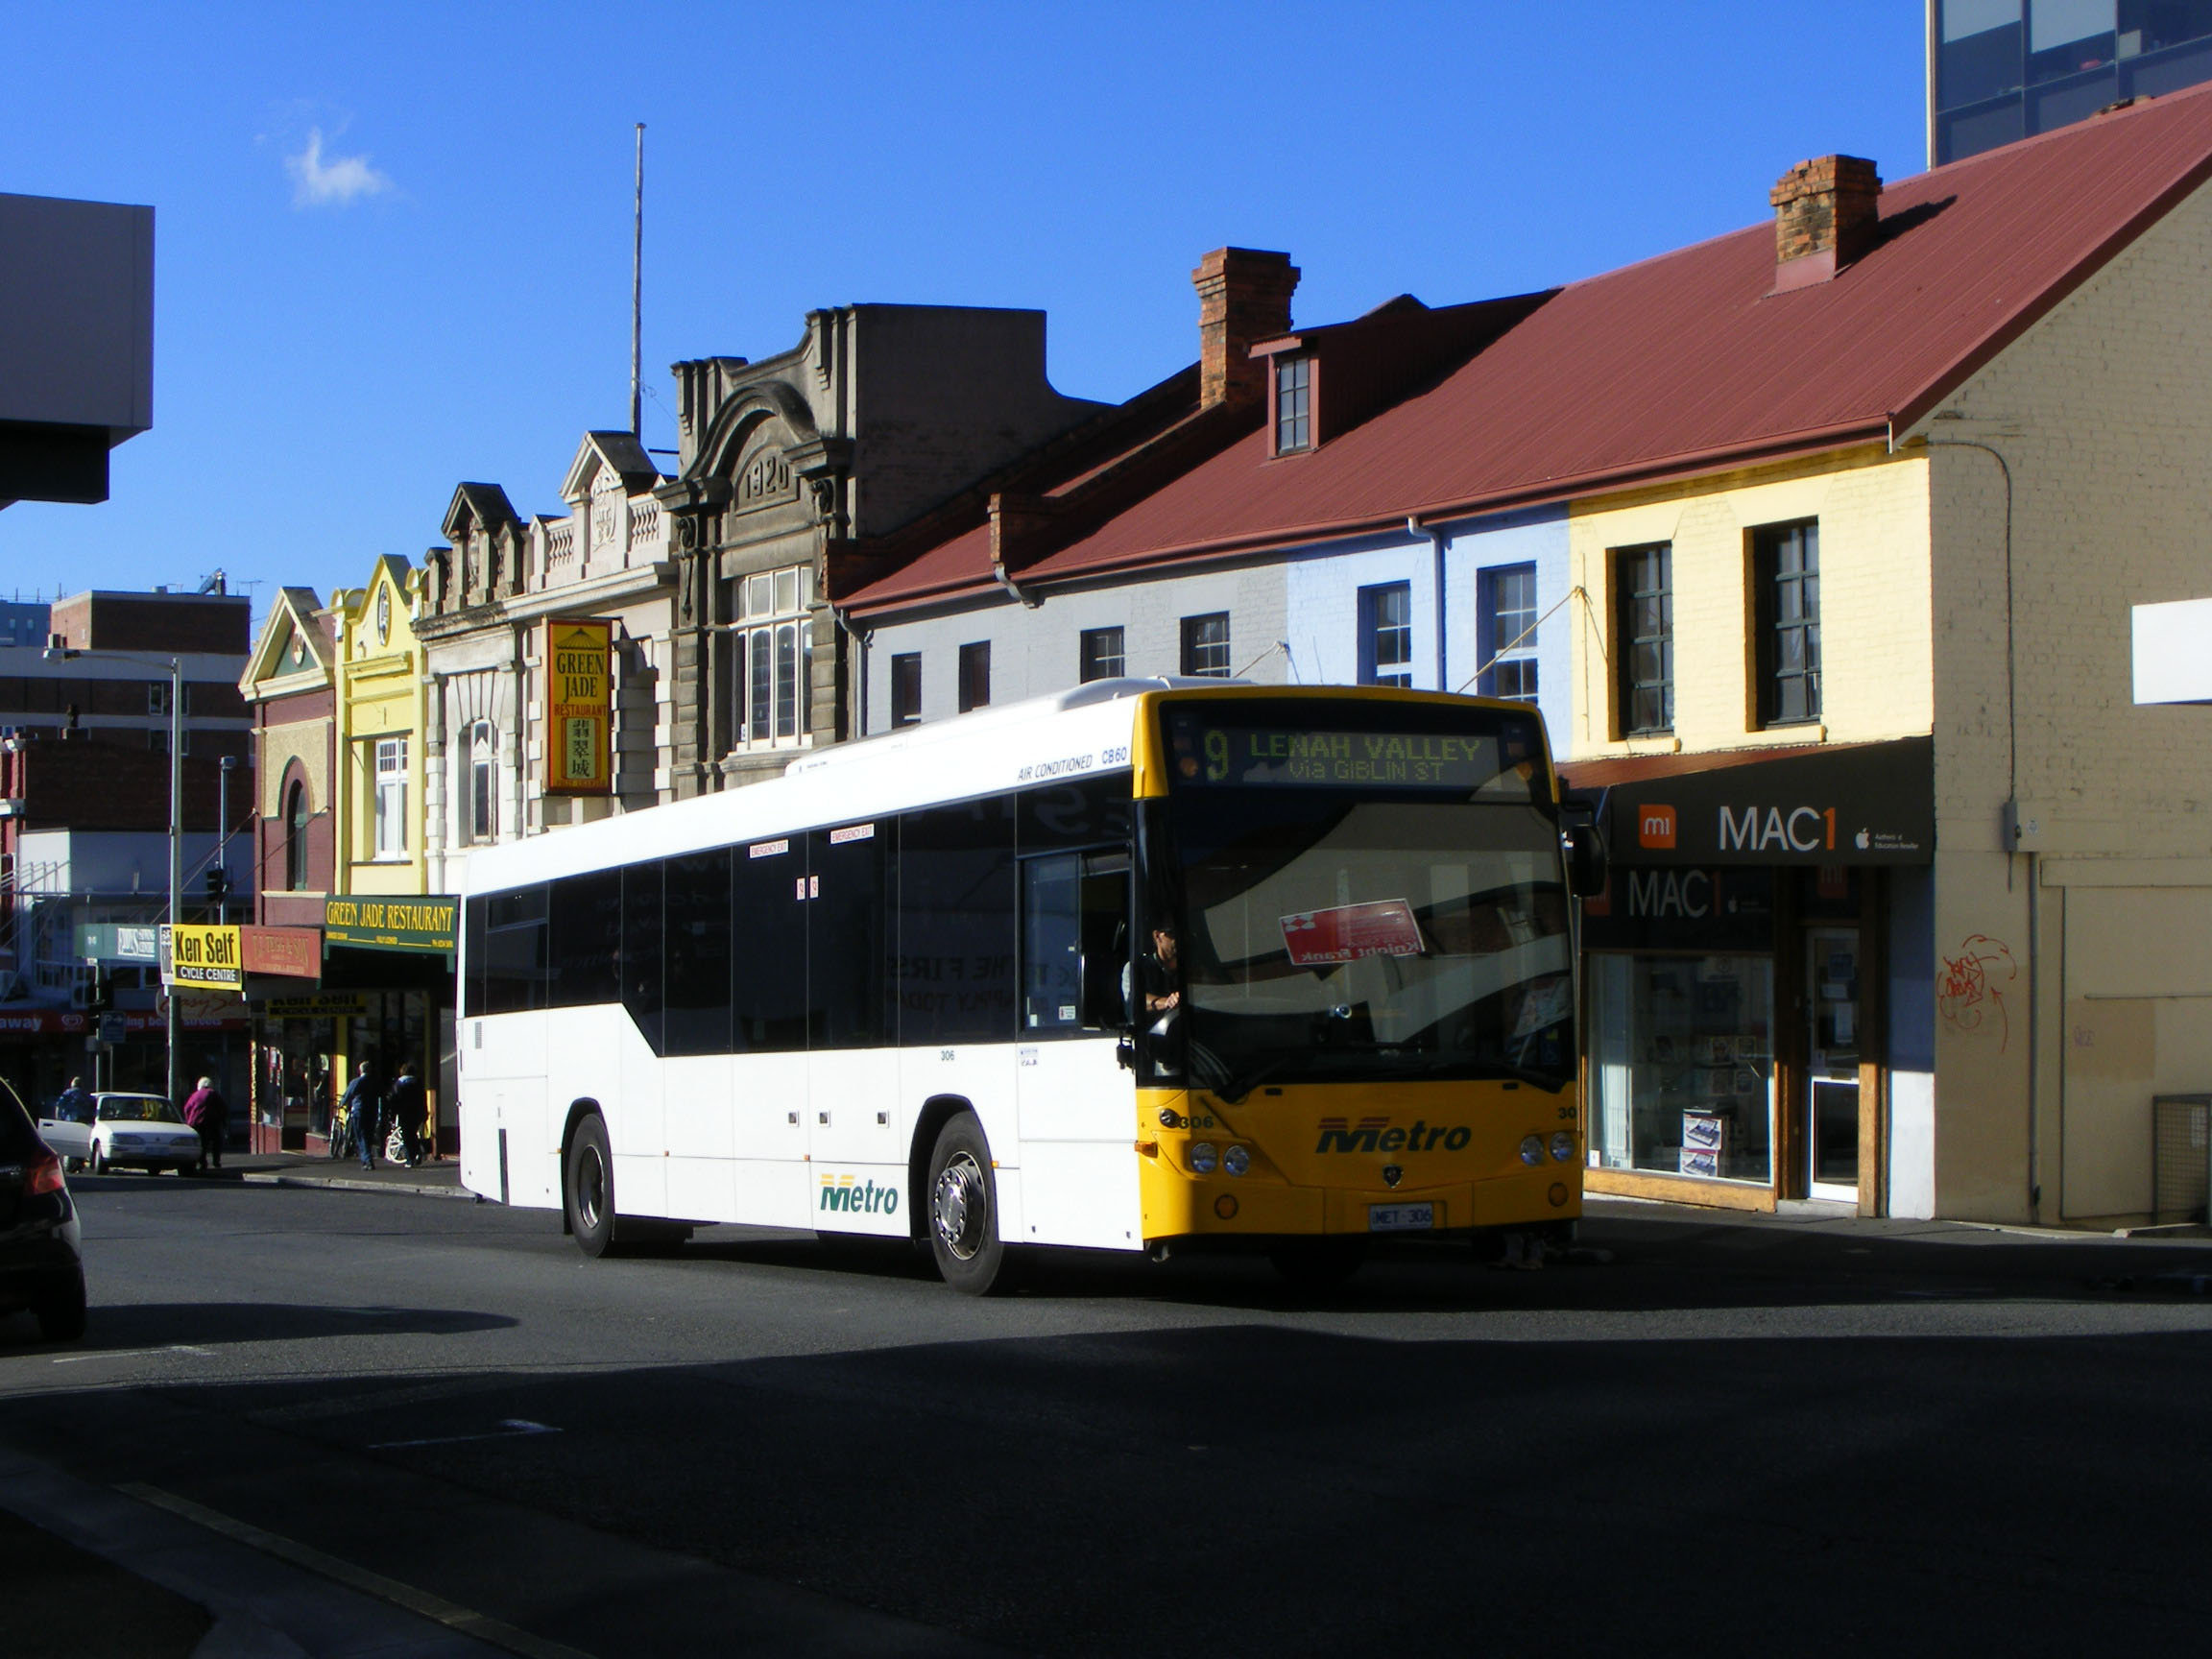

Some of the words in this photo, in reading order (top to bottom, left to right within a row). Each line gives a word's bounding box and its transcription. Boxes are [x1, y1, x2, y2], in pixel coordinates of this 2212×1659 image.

[556, 653, 605, 674] GREEN
[564, 676, 598, 703] JADE
[554, 704, 608, 717] RESTAURANT
[1204, 730, 1230, 781] 9
[1250, 733, 1351, 759] LENAH
[1364, 735, 1481, 761] VALLEY
[1018, 765, 1033, 781] AIR
[1035, 755, 1093, 779] CONDITIONED
[1288, 759, 1326, 780] via
[1415, 762, 1445, 781] ST
[832, 829, 861, 842] EMERGENCY
[861, 825, 873, 836] EXIT
[1718, 805, 1837, 852] MAC1
[751, 844, 776, 857] EMERGENCY
[777, 841, 787, 853] EXIT
[1628, 868, 1722, 919] MAC1
[326, 901, 357, 926] GREEN
[359, 903, 384, 928] JADE
[387, 904, 454, 932] RESTAURANT
[175, 930, 202, 963] Ken
[205, 932, 235, 965] Self
[180, 966, 204, 980] CYCLE
[205, 967, 236, 981] CENTRE
[940, 1049, 955, 1062] 306
[1177, 1116, 1214, 1129] 306
[1314, 1116, 1473, 1155] Metro
[819, 1173, 899, 1215] Metro
[1374, 1210, 1400, 1225] MET
